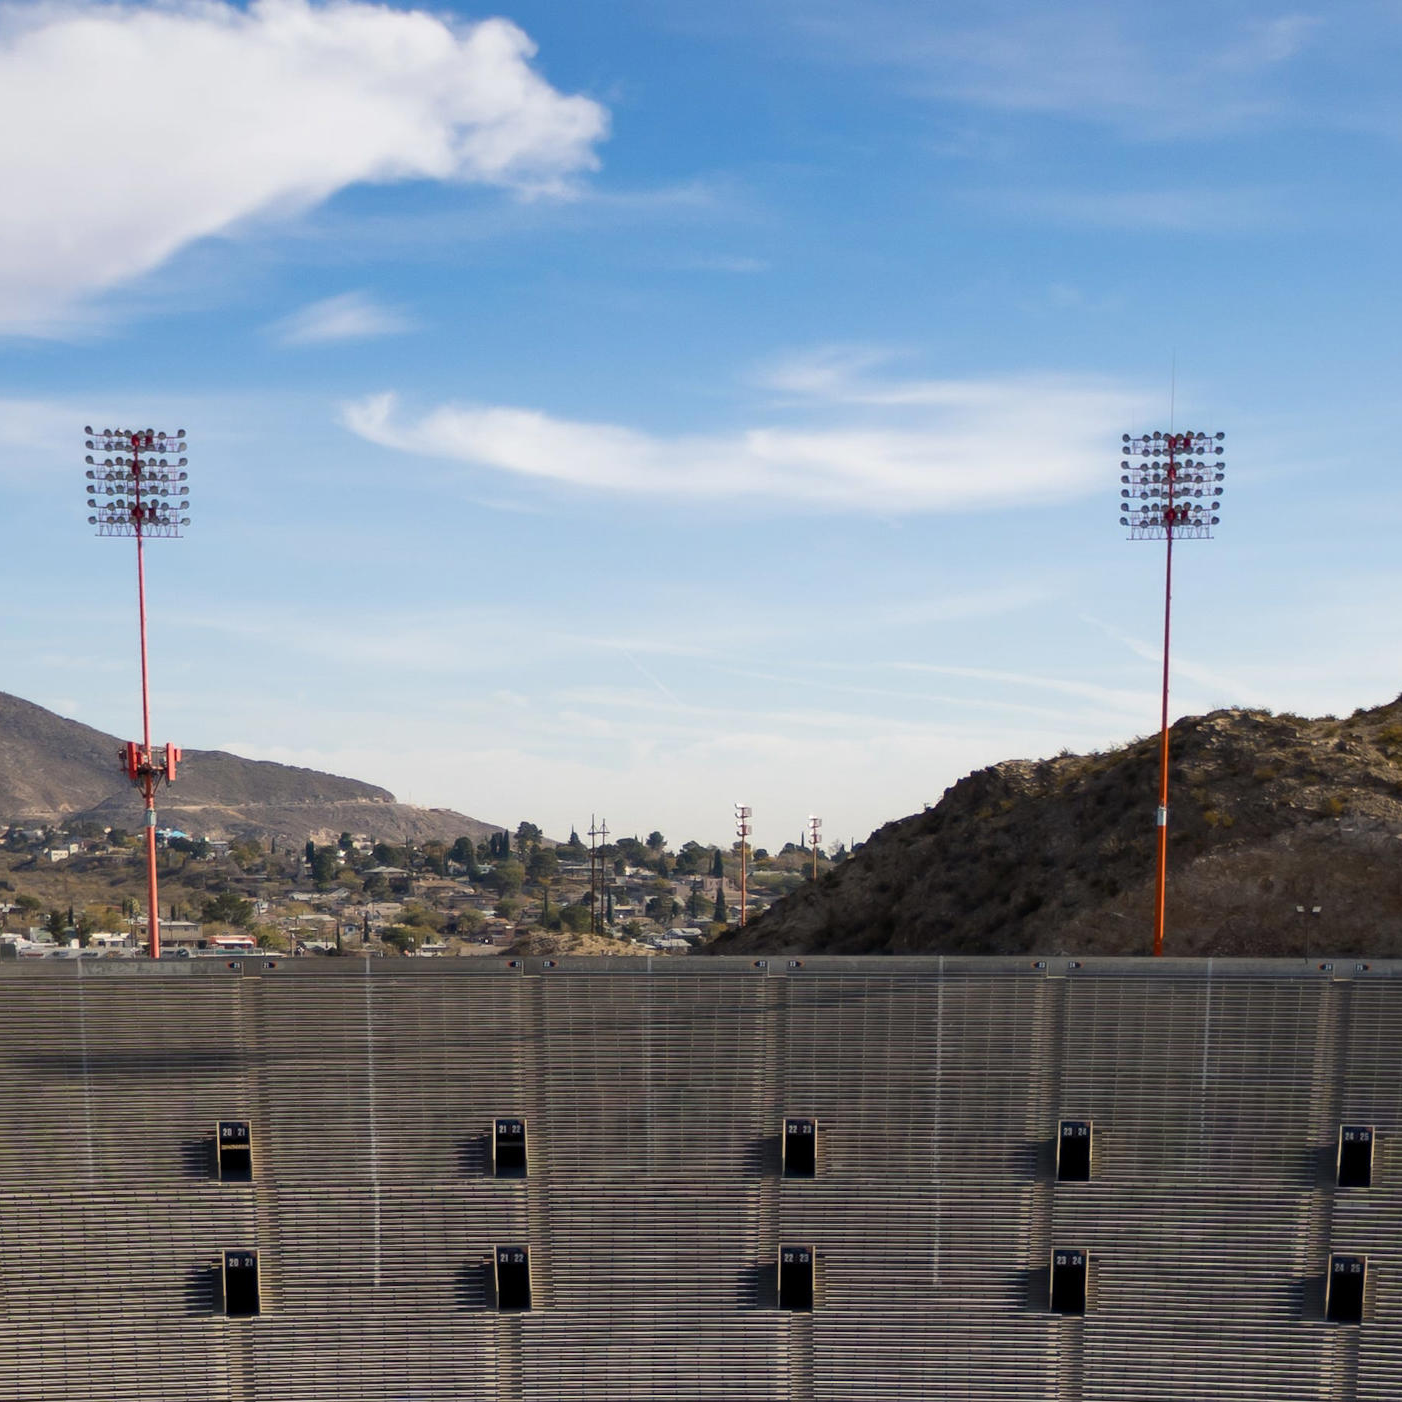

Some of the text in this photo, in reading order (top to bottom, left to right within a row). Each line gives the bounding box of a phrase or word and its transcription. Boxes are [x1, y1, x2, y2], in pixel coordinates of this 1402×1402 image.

[238, 1127, 245, 1137] 21
[498, 1125, 521, 1134] 21 22
[788, 1124, 798, 1134] 22
[245, 1257, 253, 1267] 21
[500, 1253, 524, 1263] 21 22
[784, 1252, 794, 1262] 22
